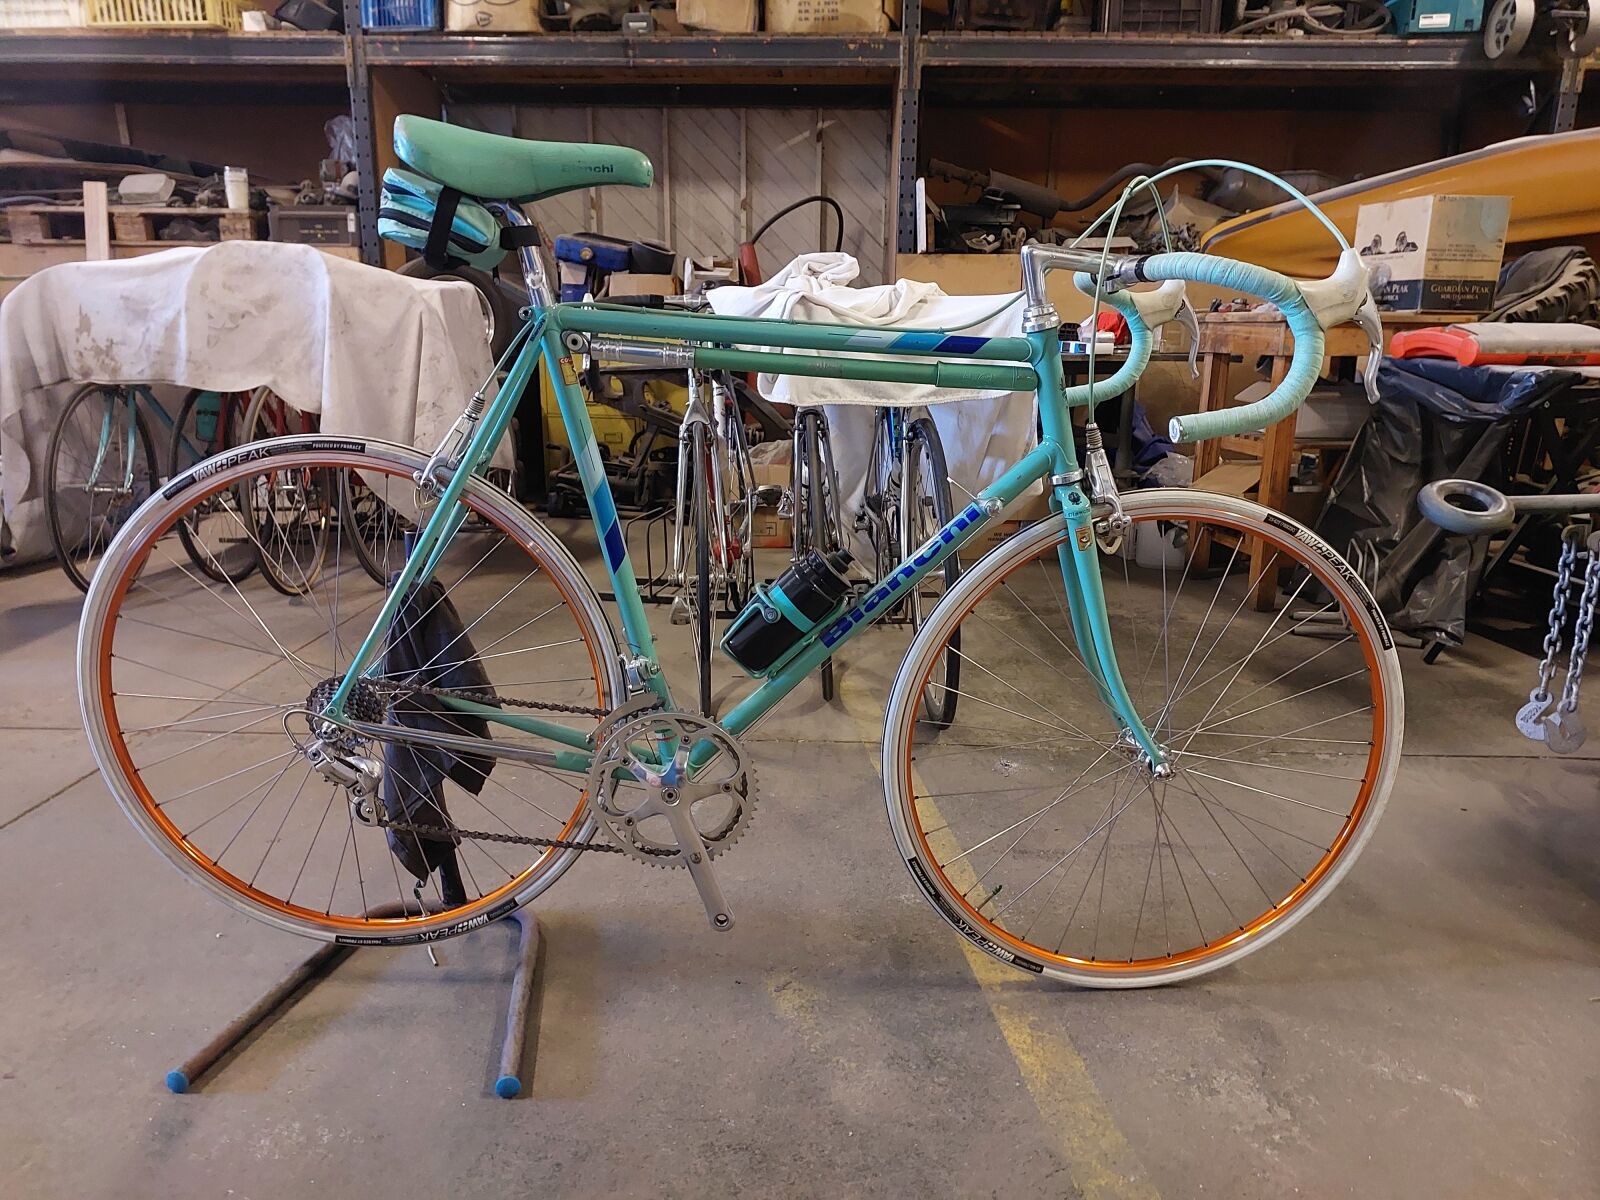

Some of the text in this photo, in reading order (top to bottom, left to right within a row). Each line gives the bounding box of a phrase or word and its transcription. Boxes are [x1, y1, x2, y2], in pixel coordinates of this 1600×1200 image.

[1391, 284, 1409, 294] PEAK
[1471, 284, 1489, 294] PEAK
[227, 447, 270, 468] PEAK
[819, 503, 982, 649] Bianchi
[1321, 551, 1354, 580] PEAK
[420, 927, 458, 942] PEAK
[957, 919, 987, 946] PEAK
